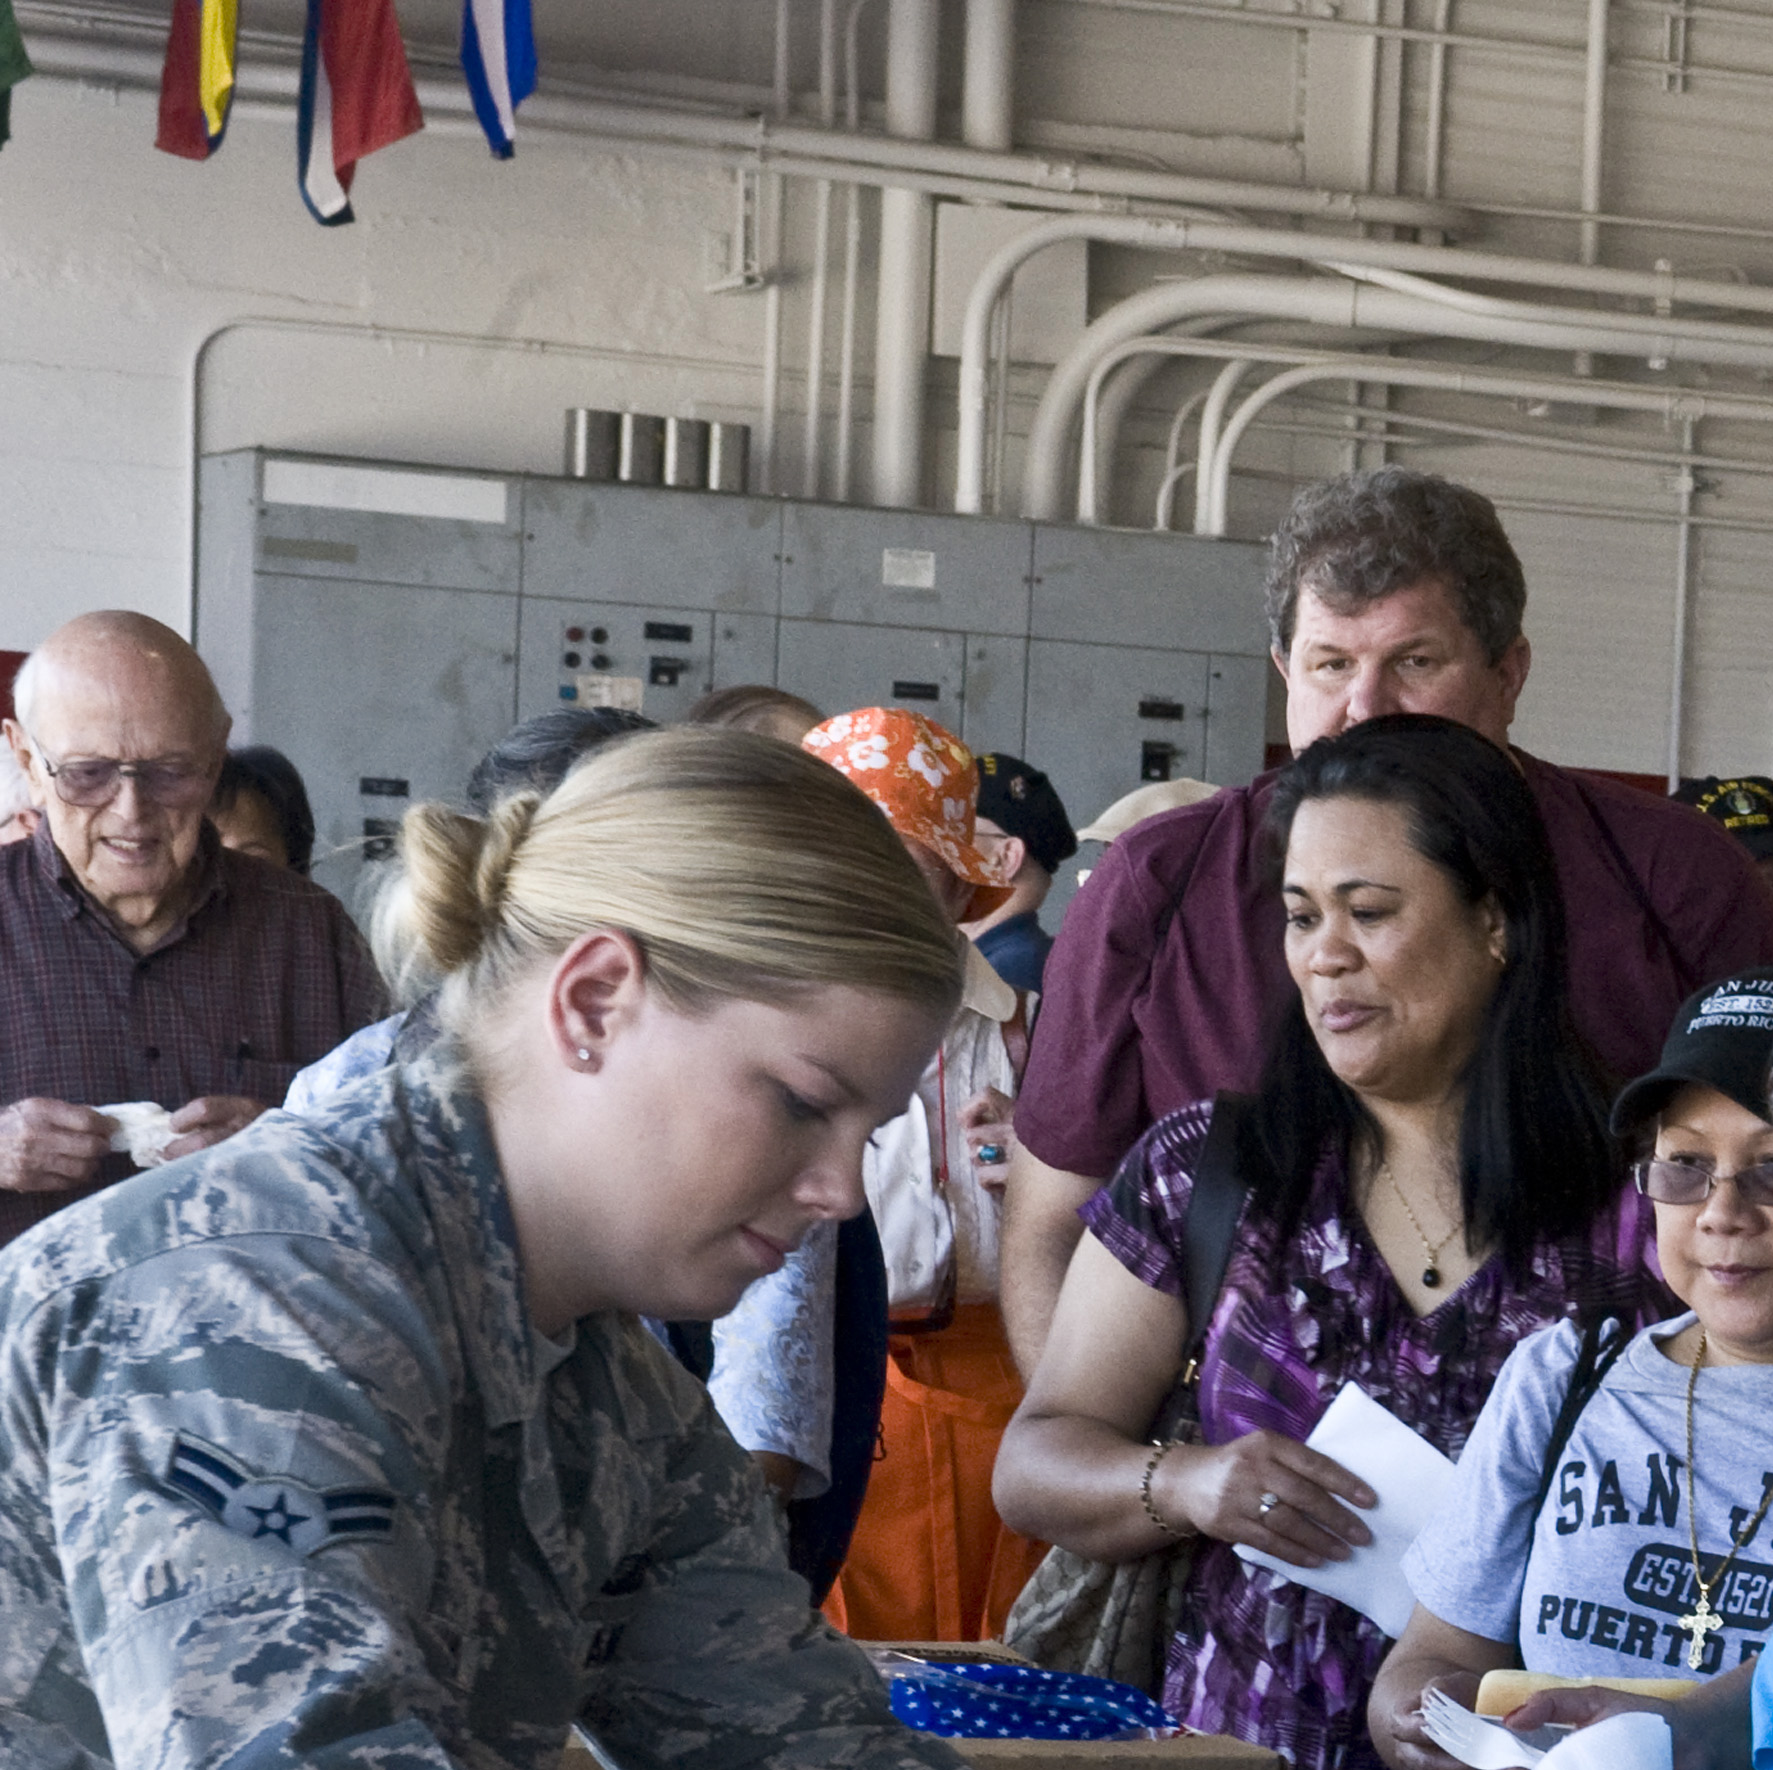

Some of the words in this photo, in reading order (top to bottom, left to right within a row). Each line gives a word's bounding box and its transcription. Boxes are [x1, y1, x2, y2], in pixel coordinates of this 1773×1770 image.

[1686, 1013, 1745, 1035] PUERTO
[1555, 1452, 1686, 1536] SAN
[1537, 1594, 1727, 1675] PUERTO
